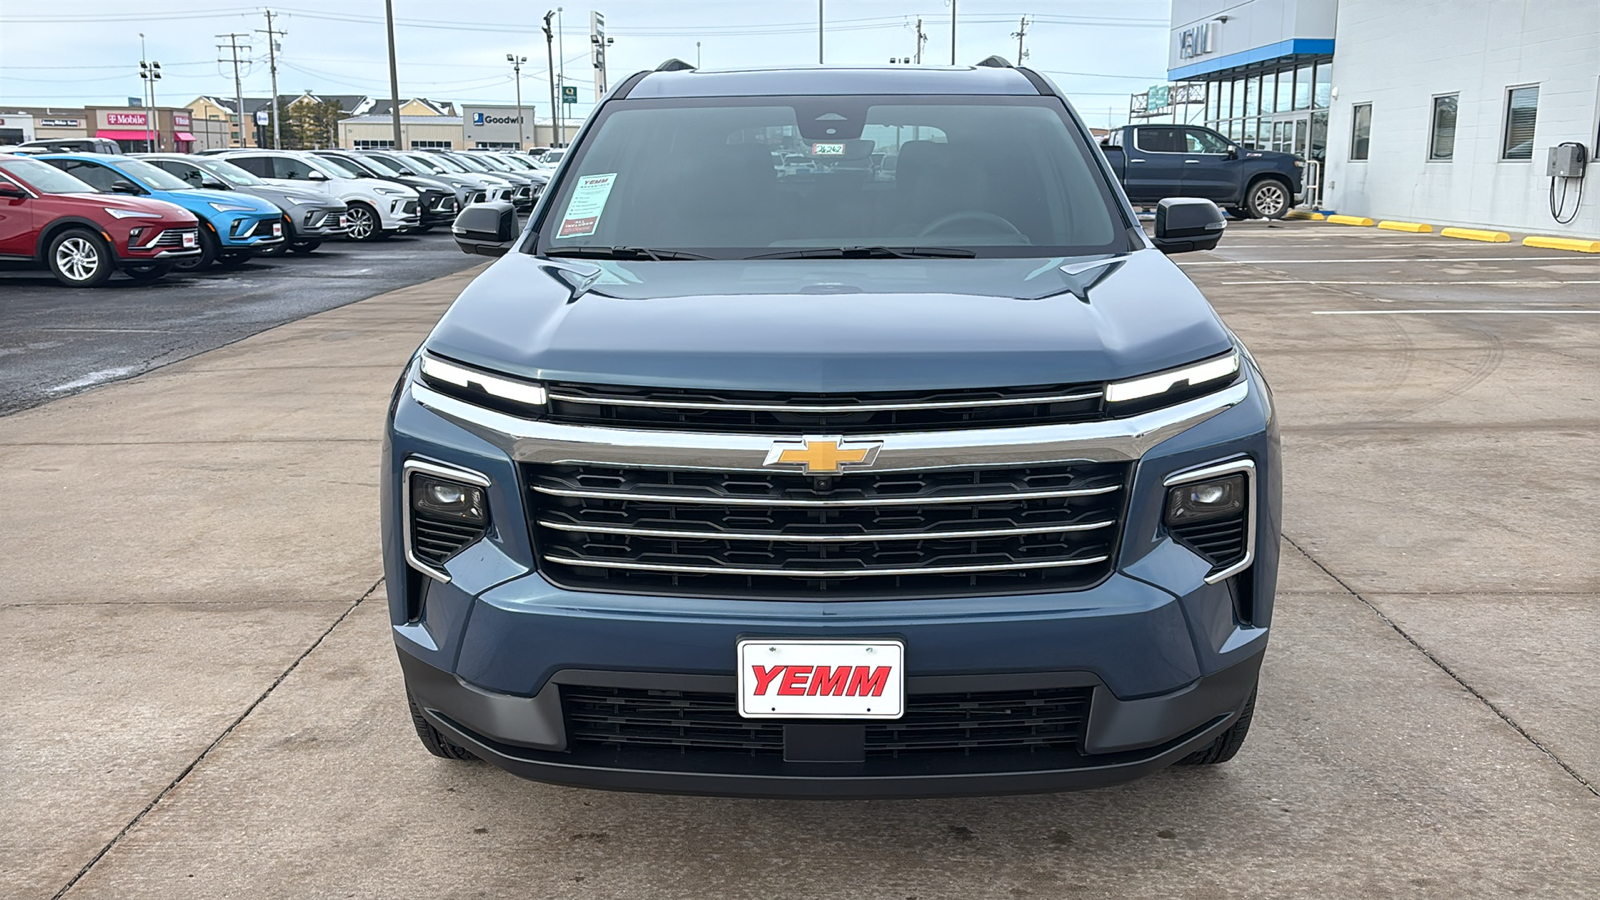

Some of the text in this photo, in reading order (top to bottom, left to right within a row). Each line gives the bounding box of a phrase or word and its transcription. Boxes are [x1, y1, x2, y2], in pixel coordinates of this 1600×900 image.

[117, 114, 145, 124] Mobile
[484, 115, 524, 124] Goodwil
[752, 665, 892, 697] YEMM
